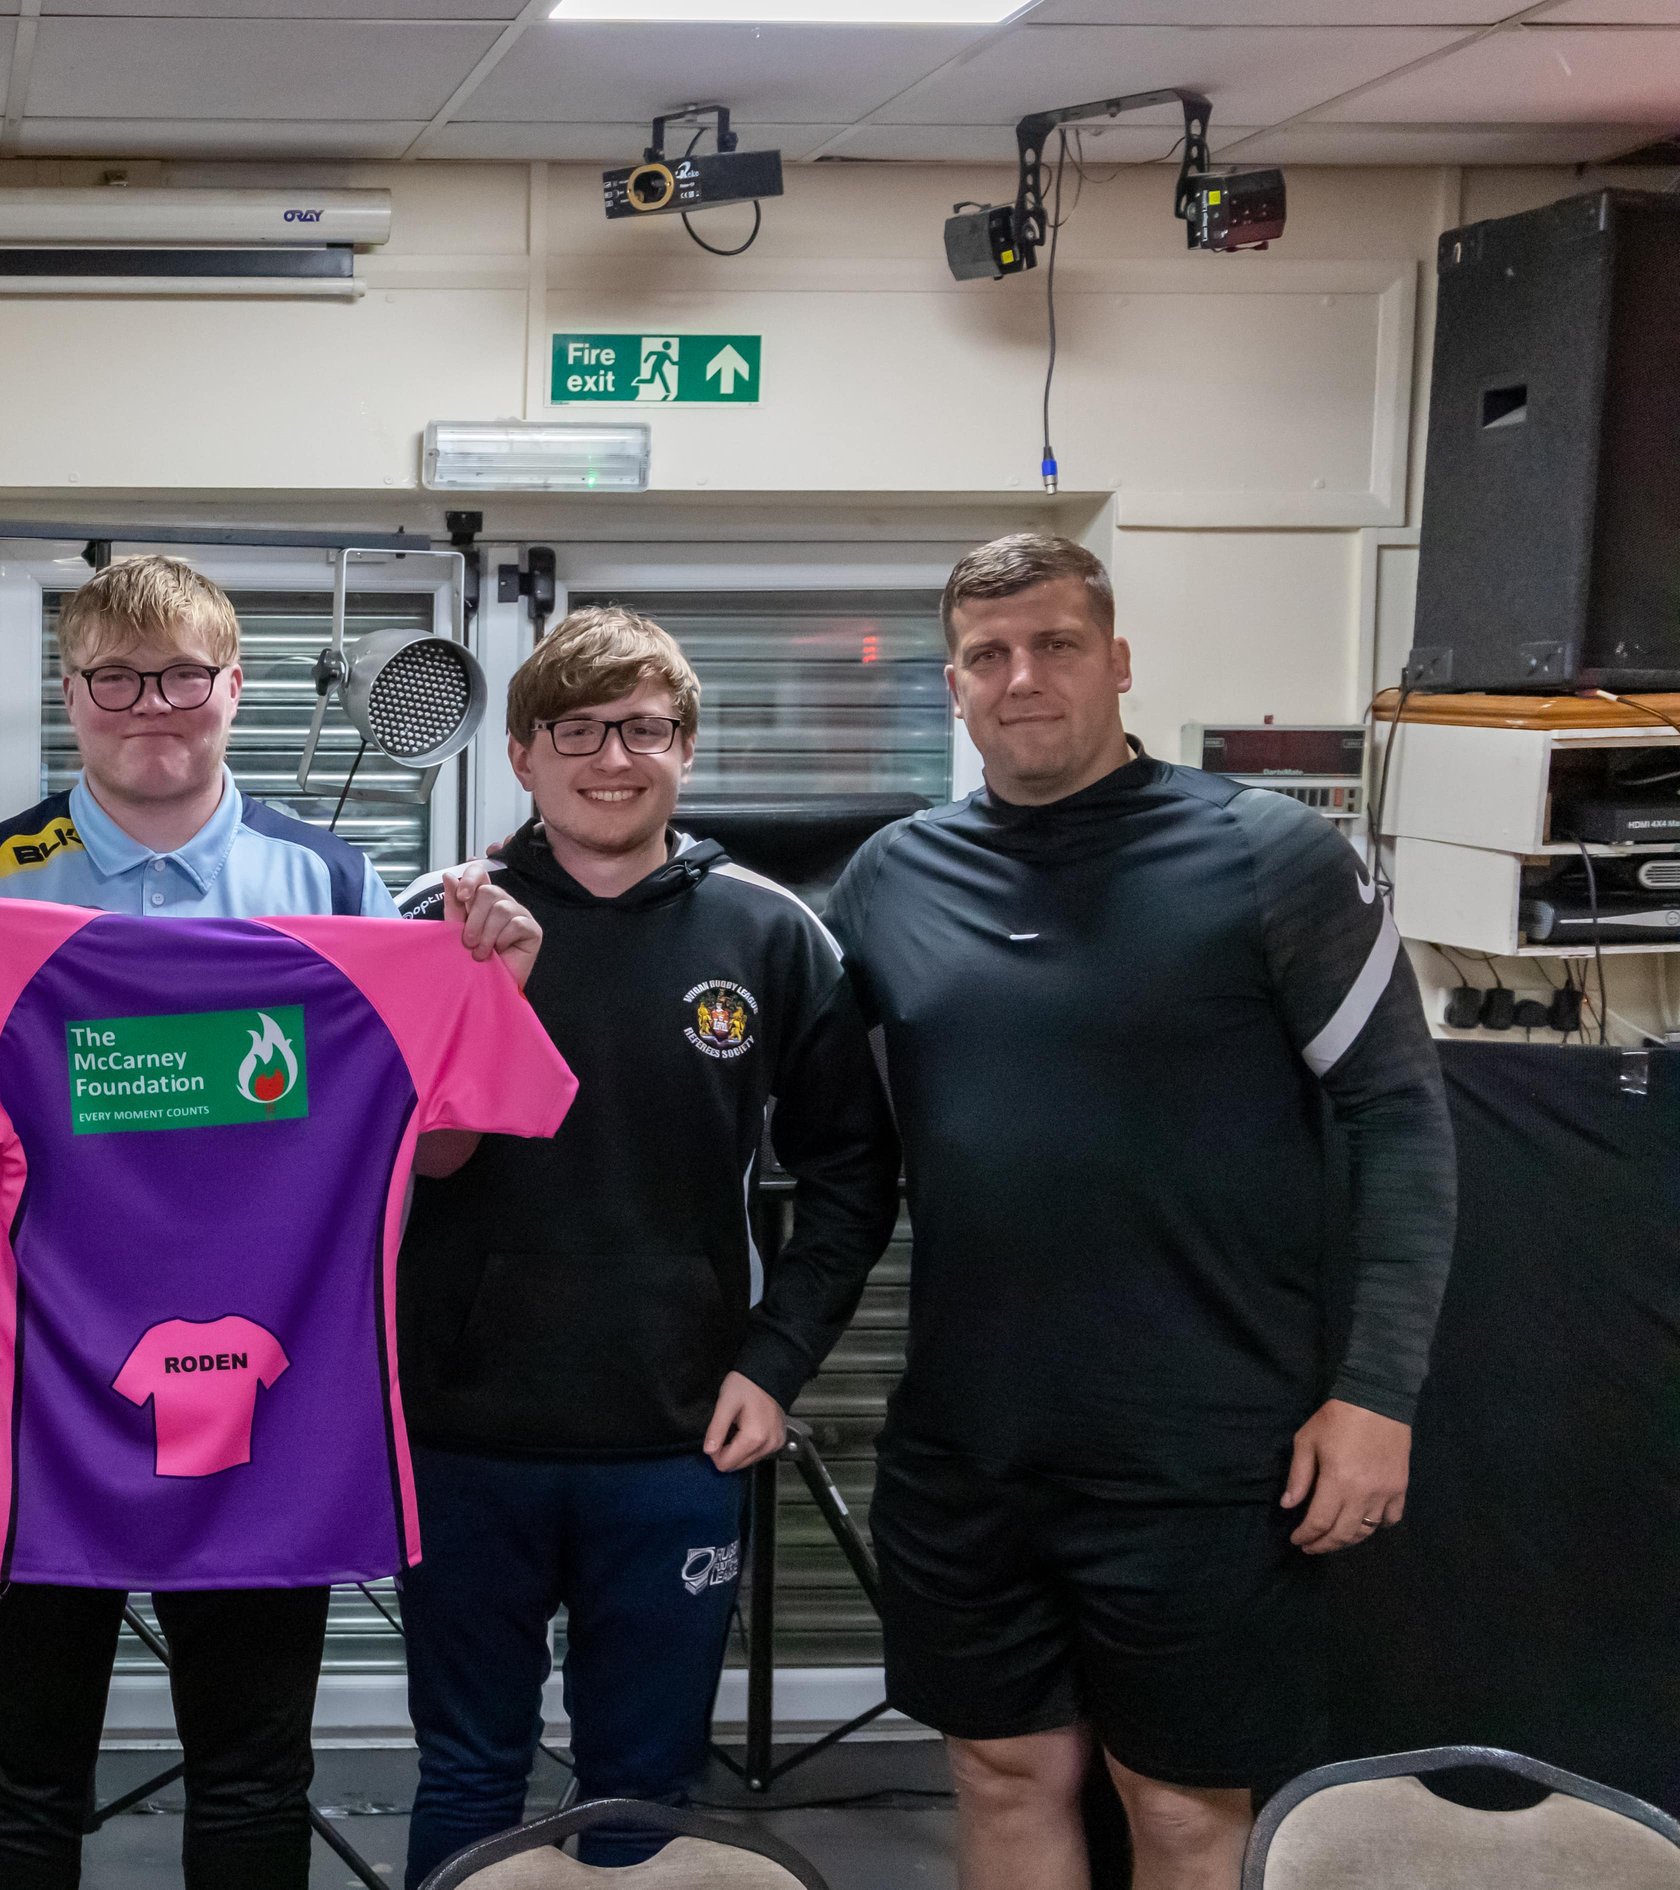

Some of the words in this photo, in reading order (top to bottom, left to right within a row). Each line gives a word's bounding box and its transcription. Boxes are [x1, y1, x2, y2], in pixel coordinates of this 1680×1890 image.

[567, 343, 616, 365] Fire
[566, 370, 616, 392] exit
[1628, 820, 1650, 829] HDMI
[12, 827, 83, 866] BLK
[682, 982, 710, 1004] WIGAN
[709, 979, 739, 991] RUGBY
[70, 1028, 116, 1047] The
[683, 1027, 720, 1058] REFEREES
[721, 1035, 755, 1059] SOCIETY
[74, 1051, 188, 1071] McCarney
[76, 1074, 205, 1097] Foundation
[79, 1112, 112, 1123] EVERY
[114, 1109, 164, 1121] MOMENT
[166, 1105, 210, 1117] COUNTS
[164, 1352, 248, 1374] RODEN
